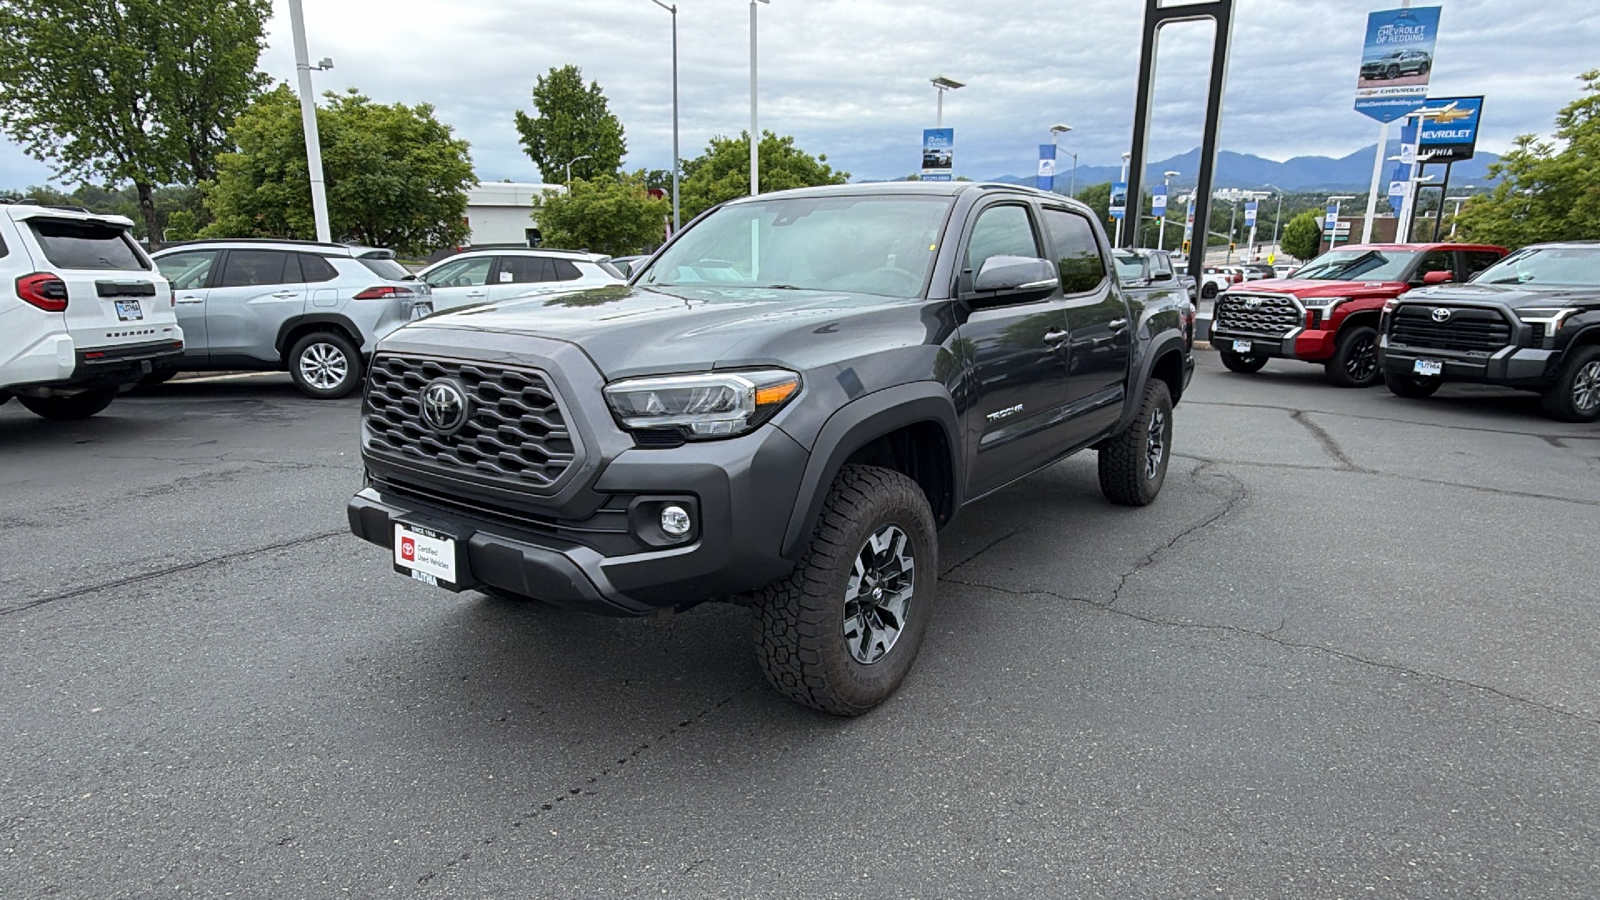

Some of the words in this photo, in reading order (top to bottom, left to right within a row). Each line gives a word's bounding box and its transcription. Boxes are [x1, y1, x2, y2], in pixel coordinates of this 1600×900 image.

[1377, 25, 1426, 37] CHEVROLET
[1376, 36, 1386, 44] OF
[1387, 34, 1424, 43] REDDING
[1421, 129, 1471, 139] HEVROLET
[1422, 148, 1453, 157] LITHIA
[123, 303, 139, 312] LITHIA
[1421, 361, 1440, 370] LITHIA
[986, 403, 1024, 421] TACOMA
[411, 525, 425, 535] SINCE
[417, 544, 438, 556] Certified
[417, 554, 429, 564] Used
[430, 558, 449, 570] Vehicles
[417, 570, 438, 587] LITHIA
